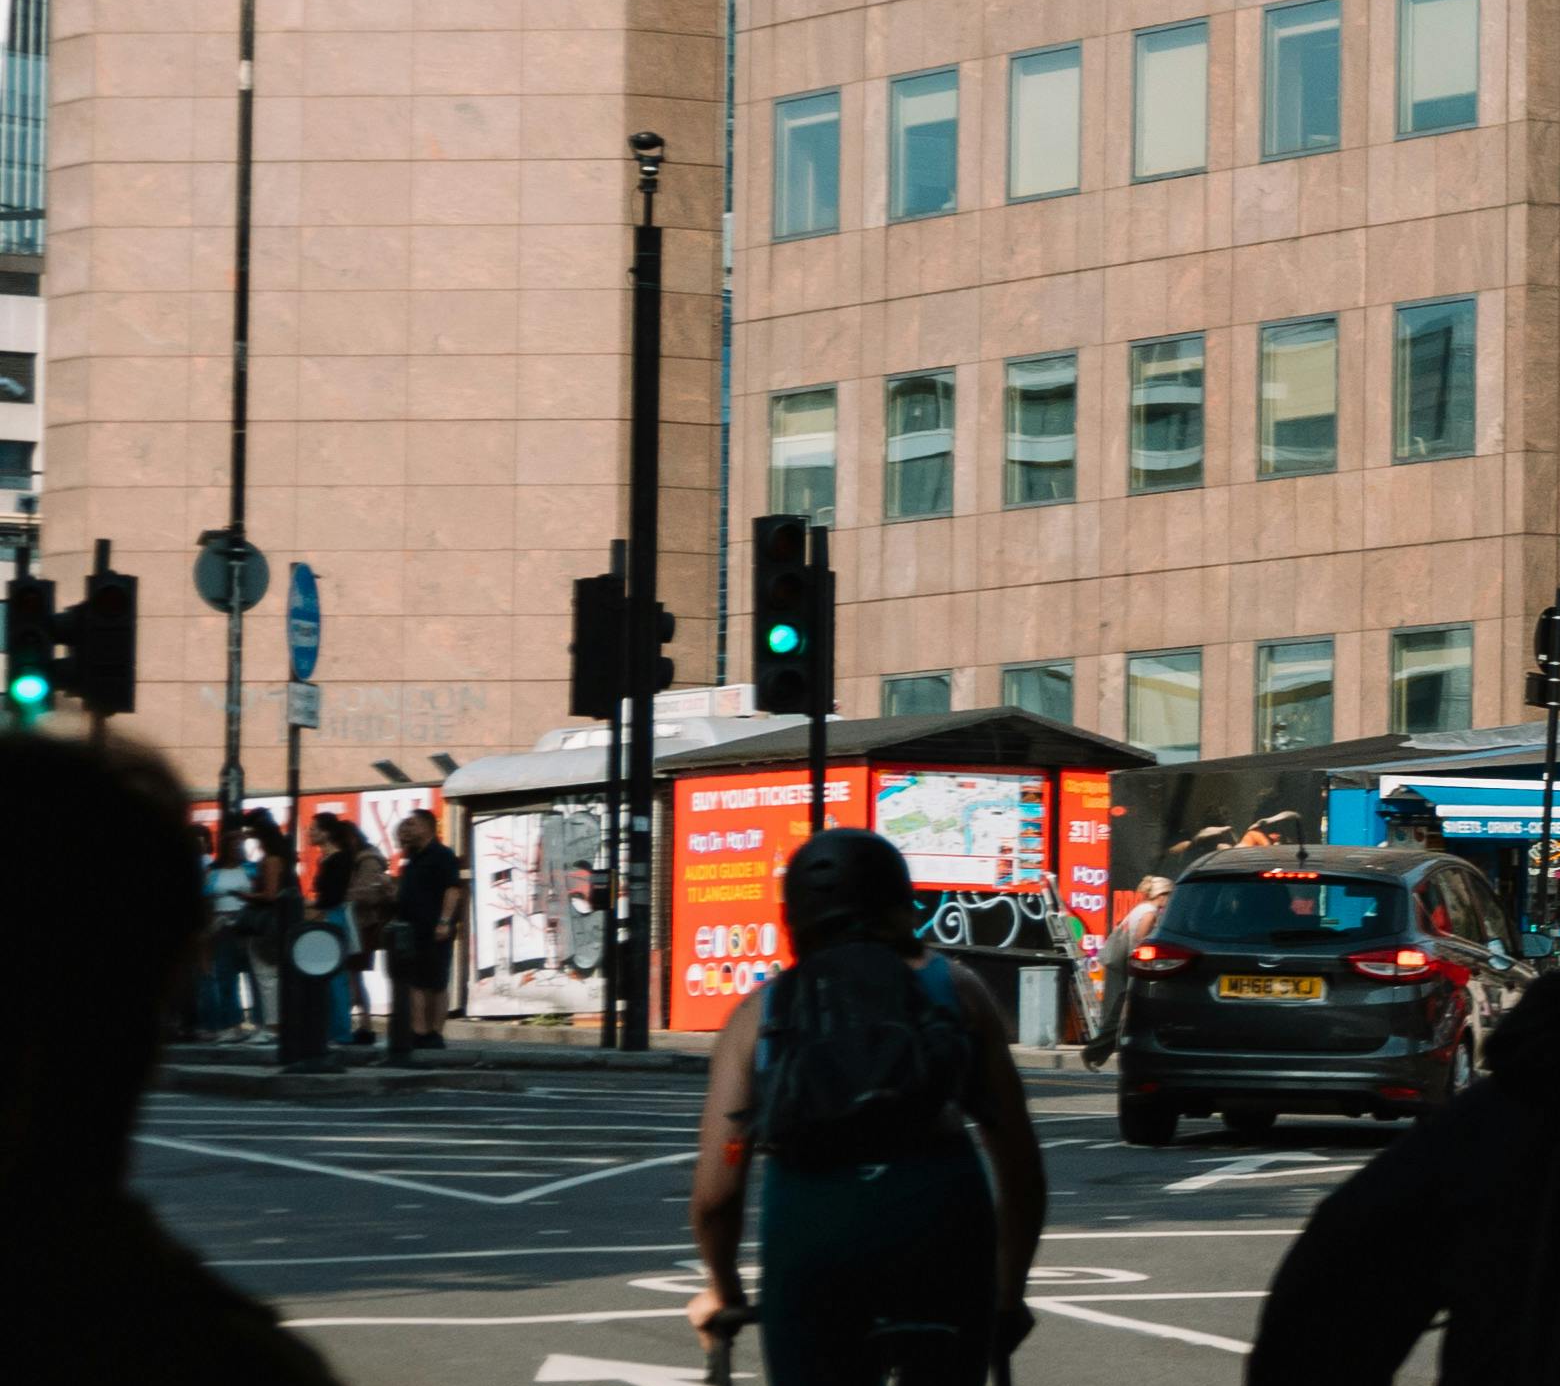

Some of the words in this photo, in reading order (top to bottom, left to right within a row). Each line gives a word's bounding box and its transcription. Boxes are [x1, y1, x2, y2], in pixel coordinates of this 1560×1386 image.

[692, 791, 718, 811] BUY
[719, 788, 757, 810] YOUR
[823, 780, 852, 803] ERE
